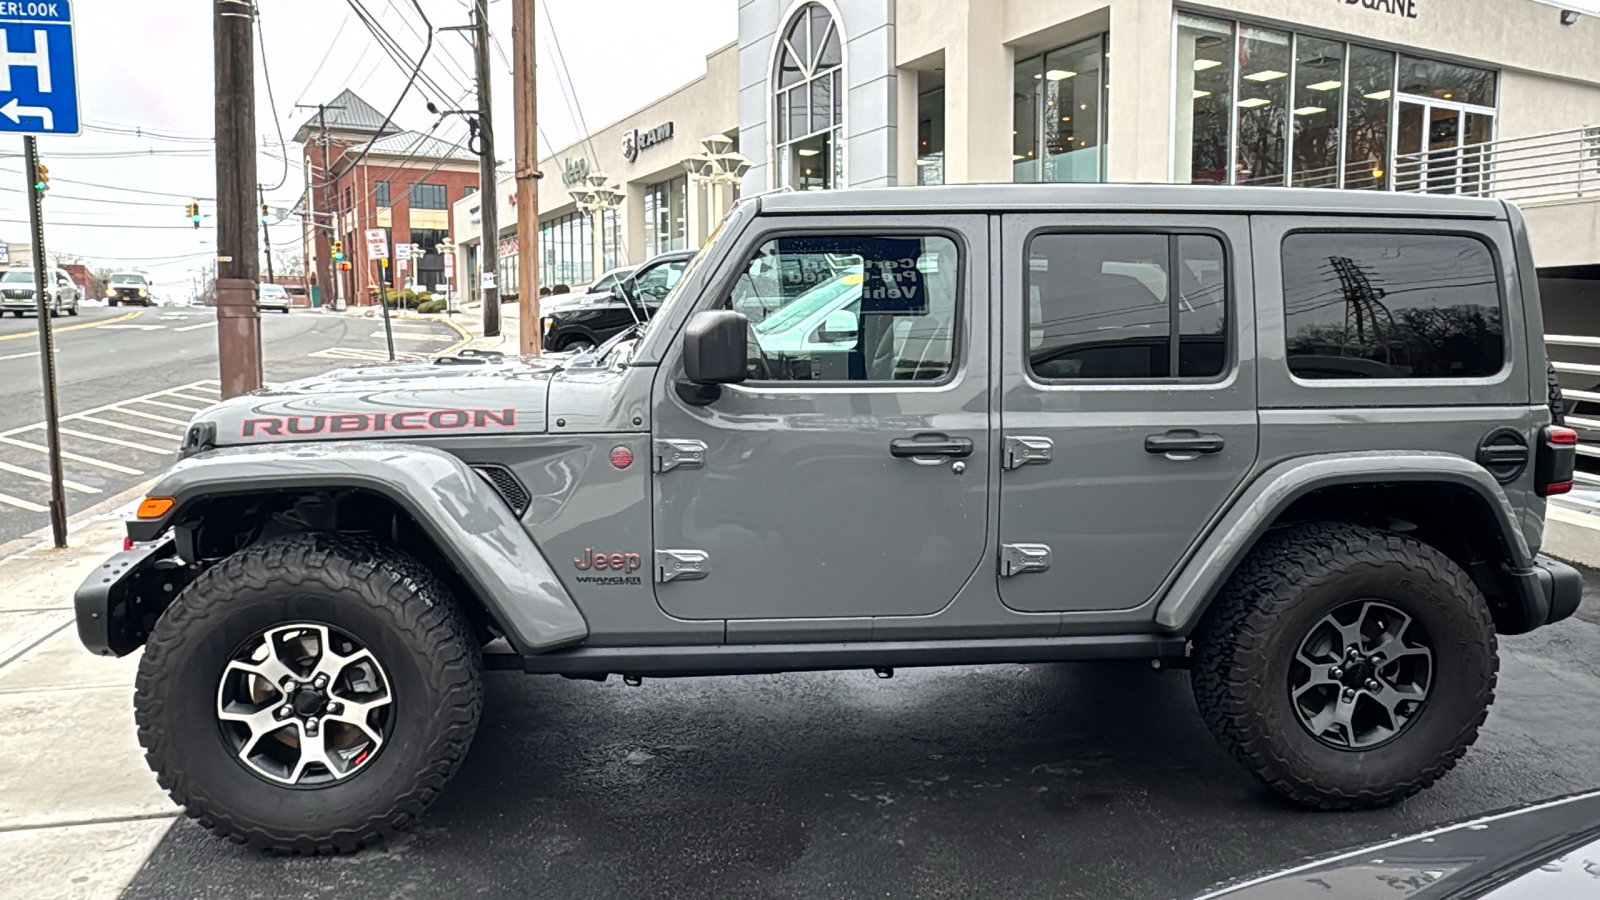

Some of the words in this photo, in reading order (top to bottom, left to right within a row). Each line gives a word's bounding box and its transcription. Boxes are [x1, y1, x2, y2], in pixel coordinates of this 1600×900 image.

[1344, 0, 1418, 19] ANE
[0, 28, 52, 93] H
[637, 121, 674, 151] RAM
[242, 408, 517, 438] RUBICON
[574, 547, 642, 574] Jeep
